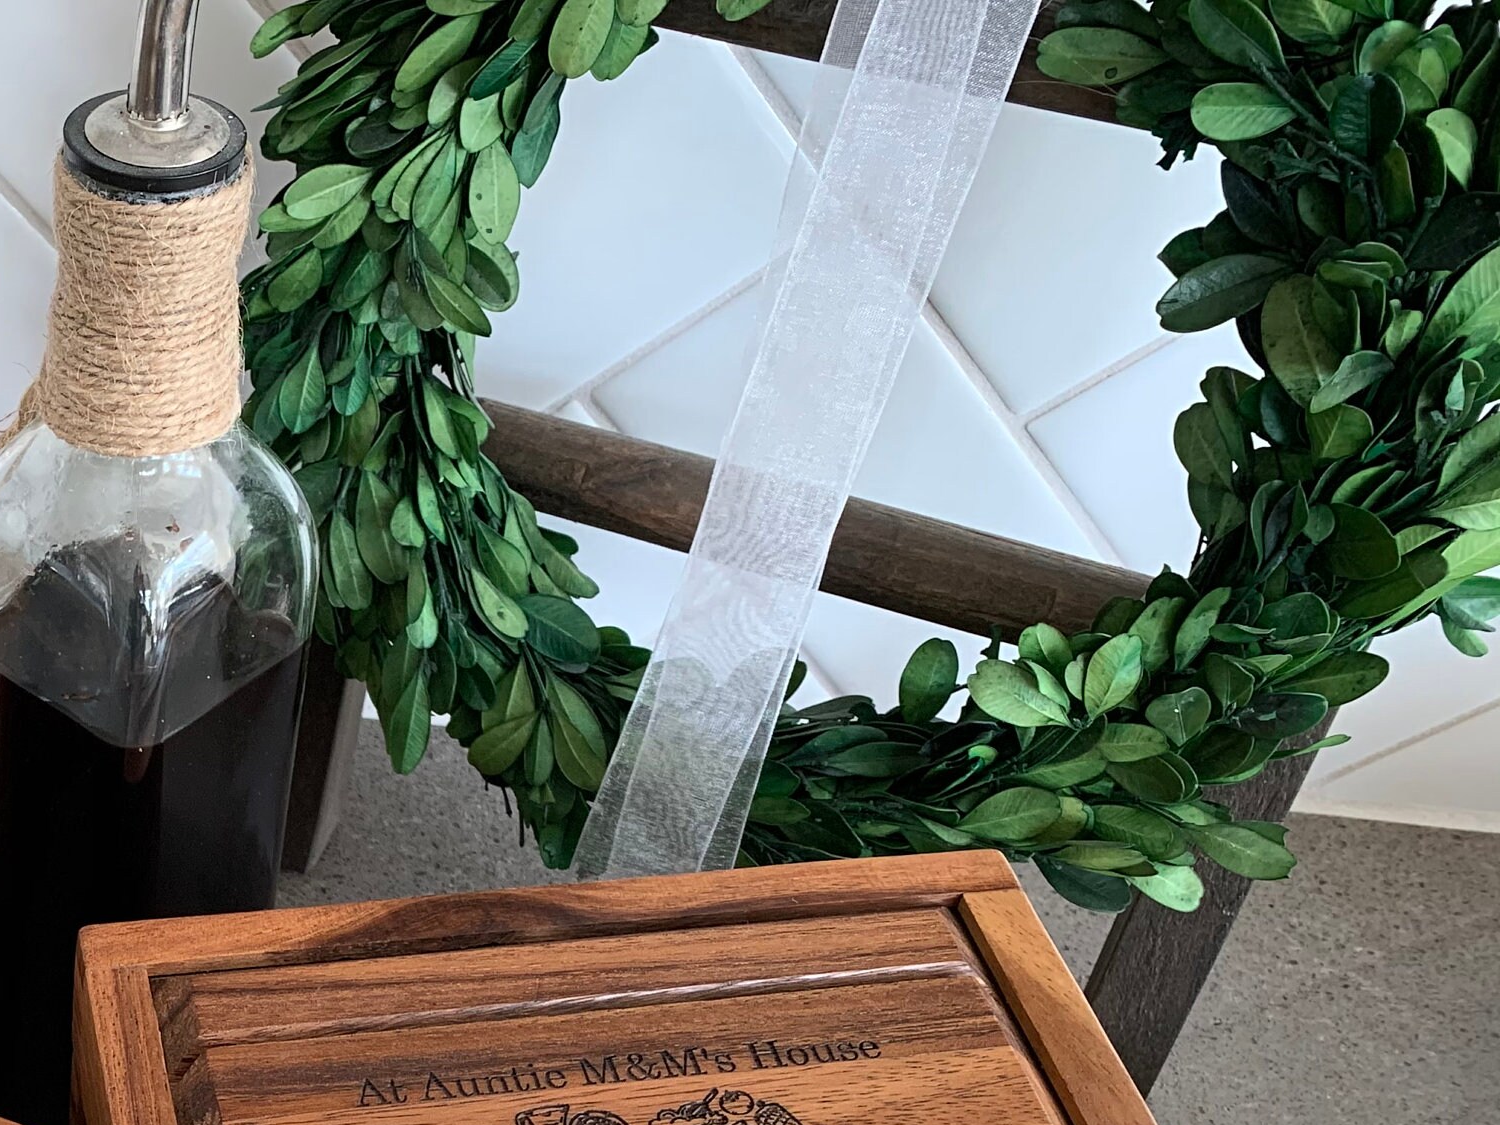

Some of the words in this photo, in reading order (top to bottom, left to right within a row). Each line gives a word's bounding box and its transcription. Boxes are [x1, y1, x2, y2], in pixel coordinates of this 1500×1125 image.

[356, 1069, 408, 1108] At
[420, 1061, 568, 1102] Auntie
[579, 1045, 738, 1088] M&M's
[750, 1035, 883, 1070] House
